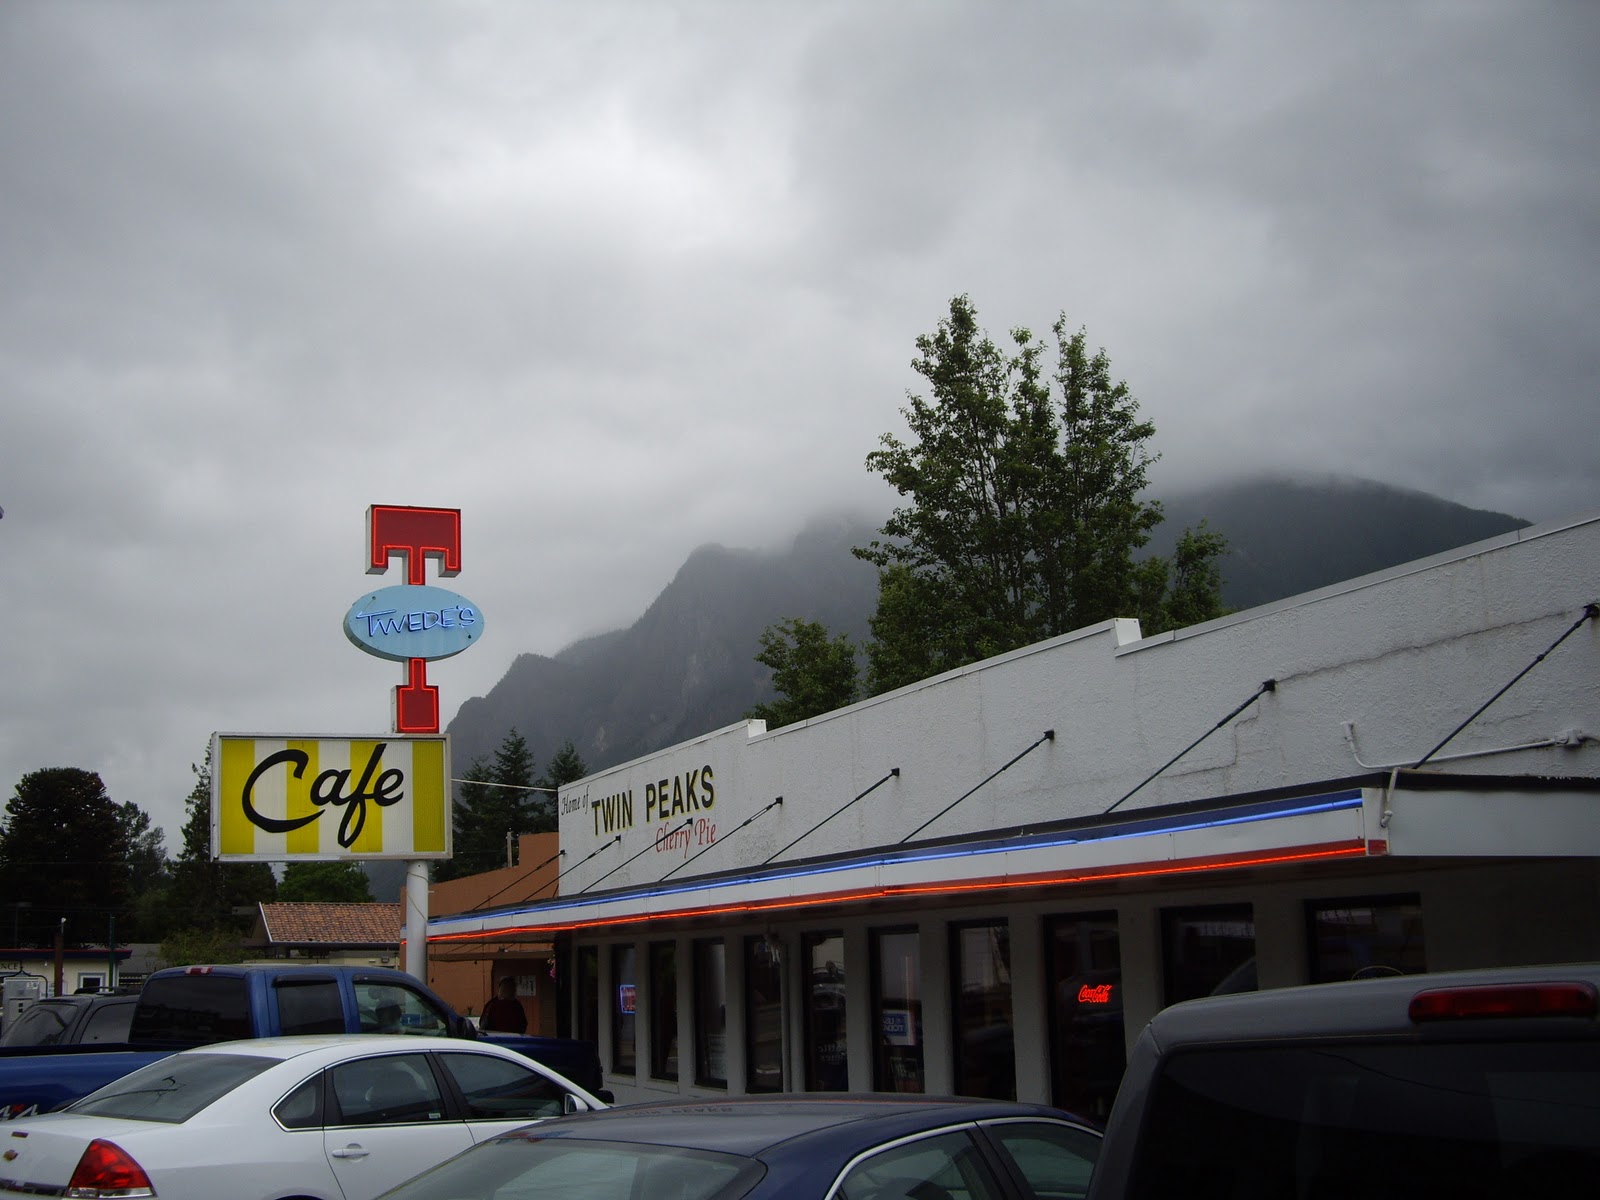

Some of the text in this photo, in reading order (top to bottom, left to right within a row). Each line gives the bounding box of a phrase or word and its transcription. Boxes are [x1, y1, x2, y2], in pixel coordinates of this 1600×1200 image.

[355, 605, 475, 637] TWEDE'S
[242, 743, 404, 849] Cafe
[561, 785, 590, 816] Home of
[591, 764, 716, 836] TWIN PEAKS
[655, 818, 717, 859] Cherry Pie
